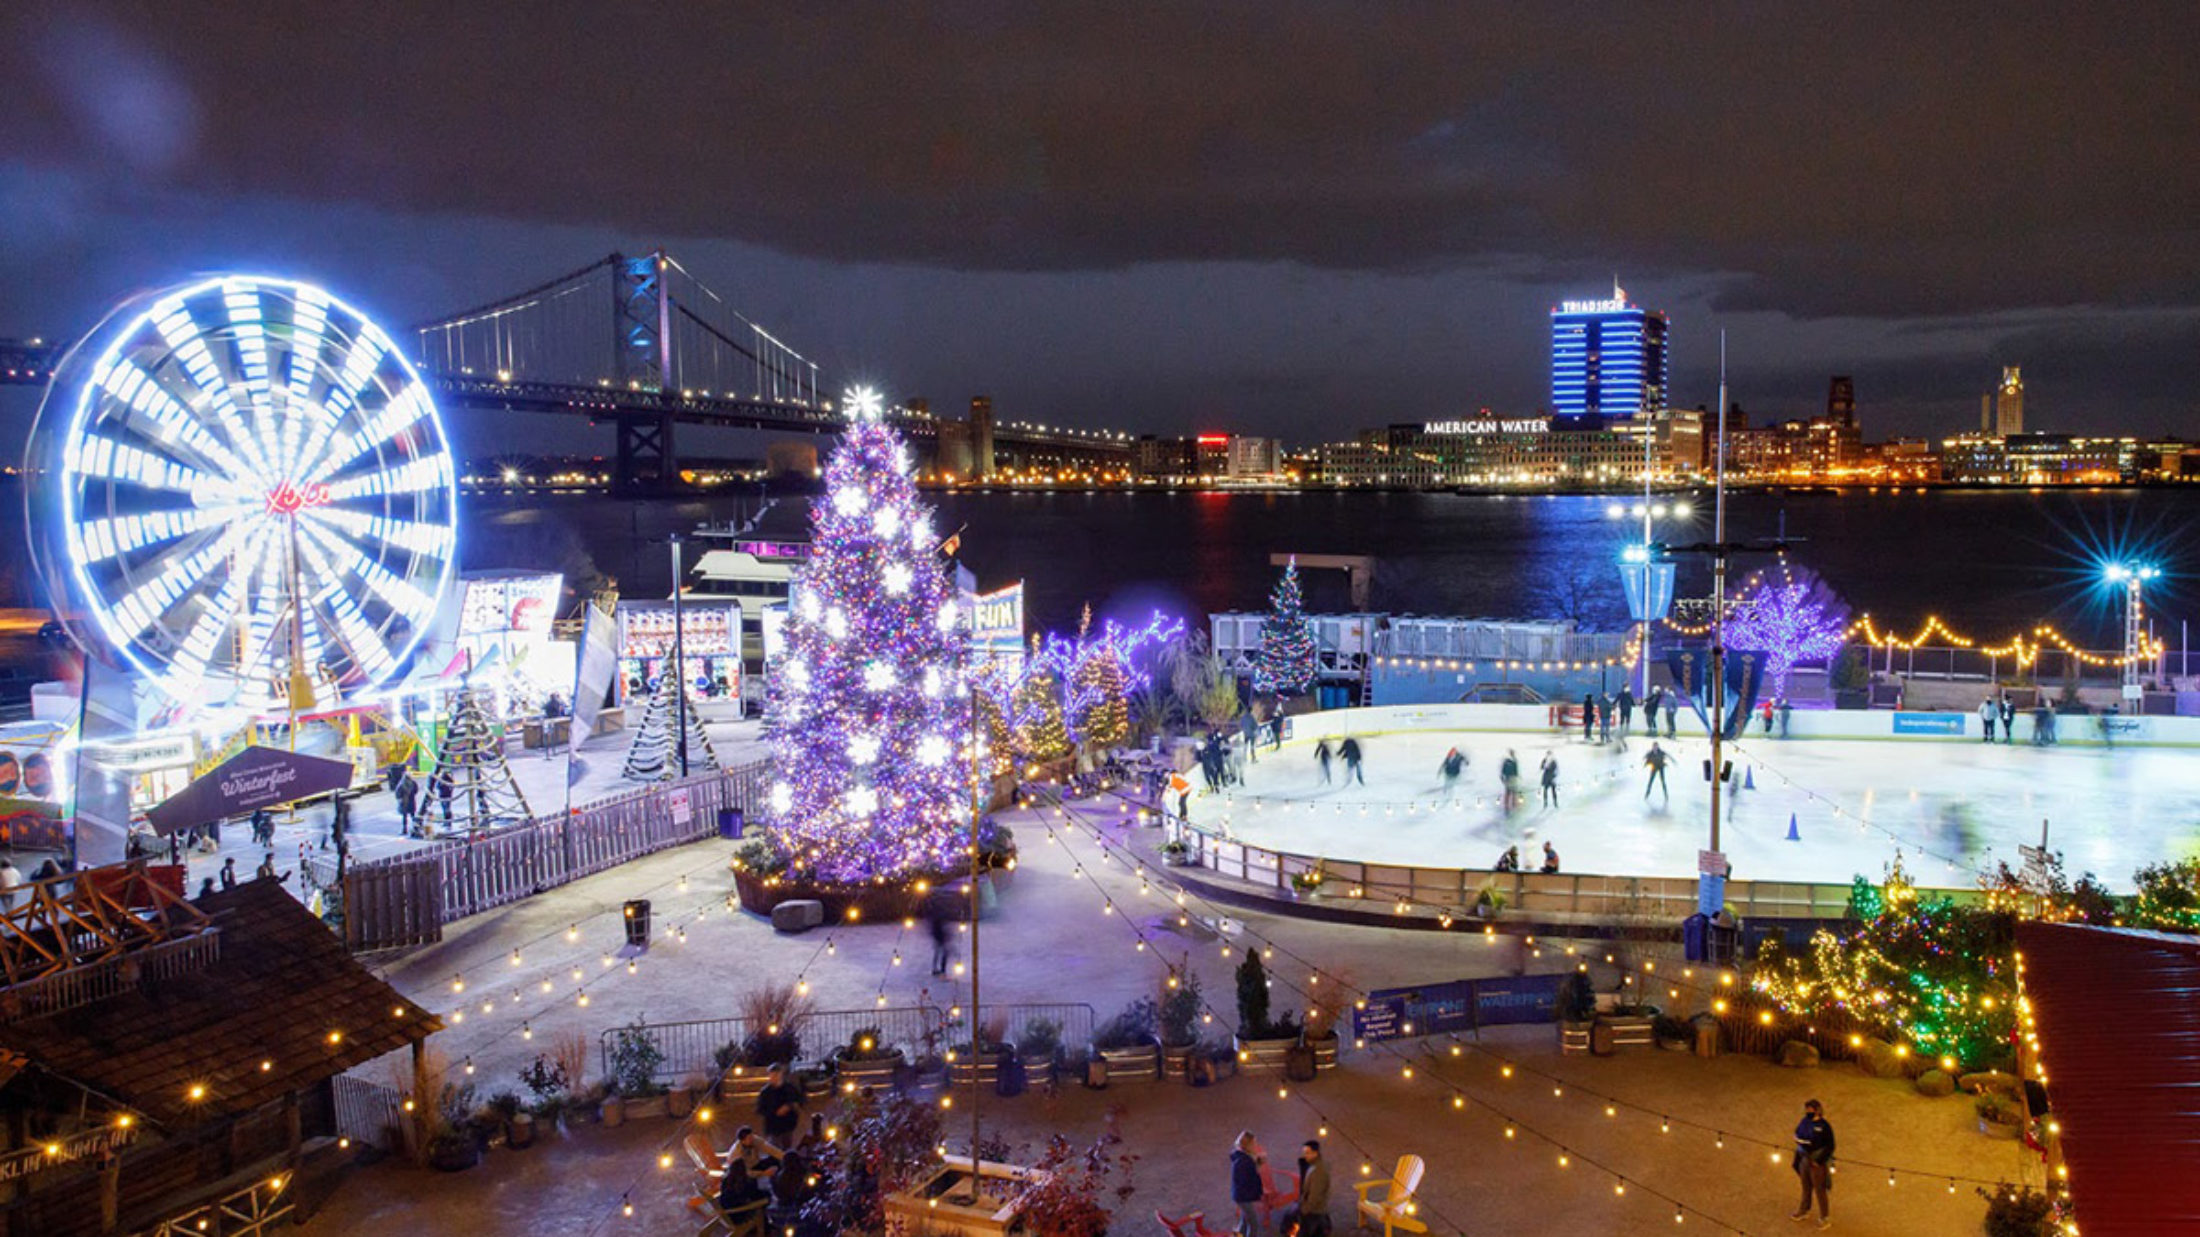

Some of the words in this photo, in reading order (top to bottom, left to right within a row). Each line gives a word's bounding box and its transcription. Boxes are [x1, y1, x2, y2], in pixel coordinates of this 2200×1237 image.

[1424, 421, 1497, 434] AMERICAN
[1501, 420, 1549, 433] WATER
[975, 601, 1015, 631] FUN
[221, 767, 297, 797] Winterfest
